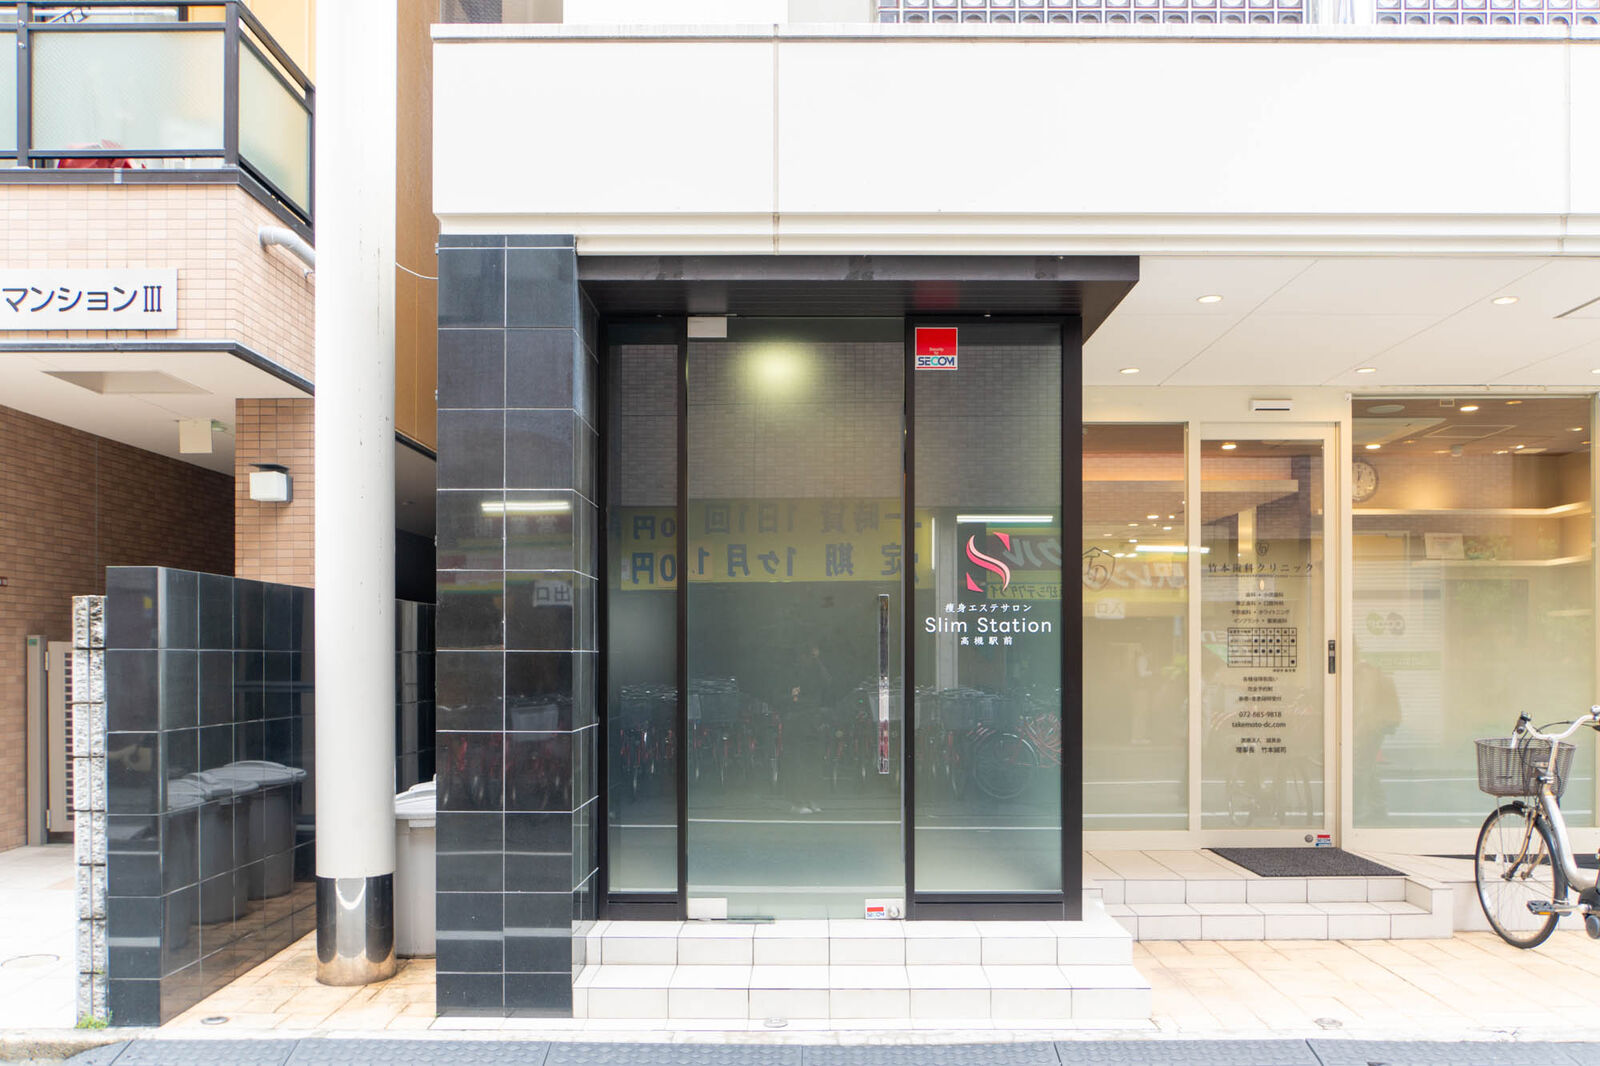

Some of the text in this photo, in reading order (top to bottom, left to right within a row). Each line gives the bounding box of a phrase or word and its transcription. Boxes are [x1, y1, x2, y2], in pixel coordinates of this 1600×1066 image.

[918, 356, 955, 366] SECOM
[1208, 562, 1313, 574] 竹本歯科クリニック
[945, 603, 1032, 613] 痩身エステサロン
[925, 616, 1052, 633] Slim Station
[960, 636, 1013, 646] 高槻駅前
